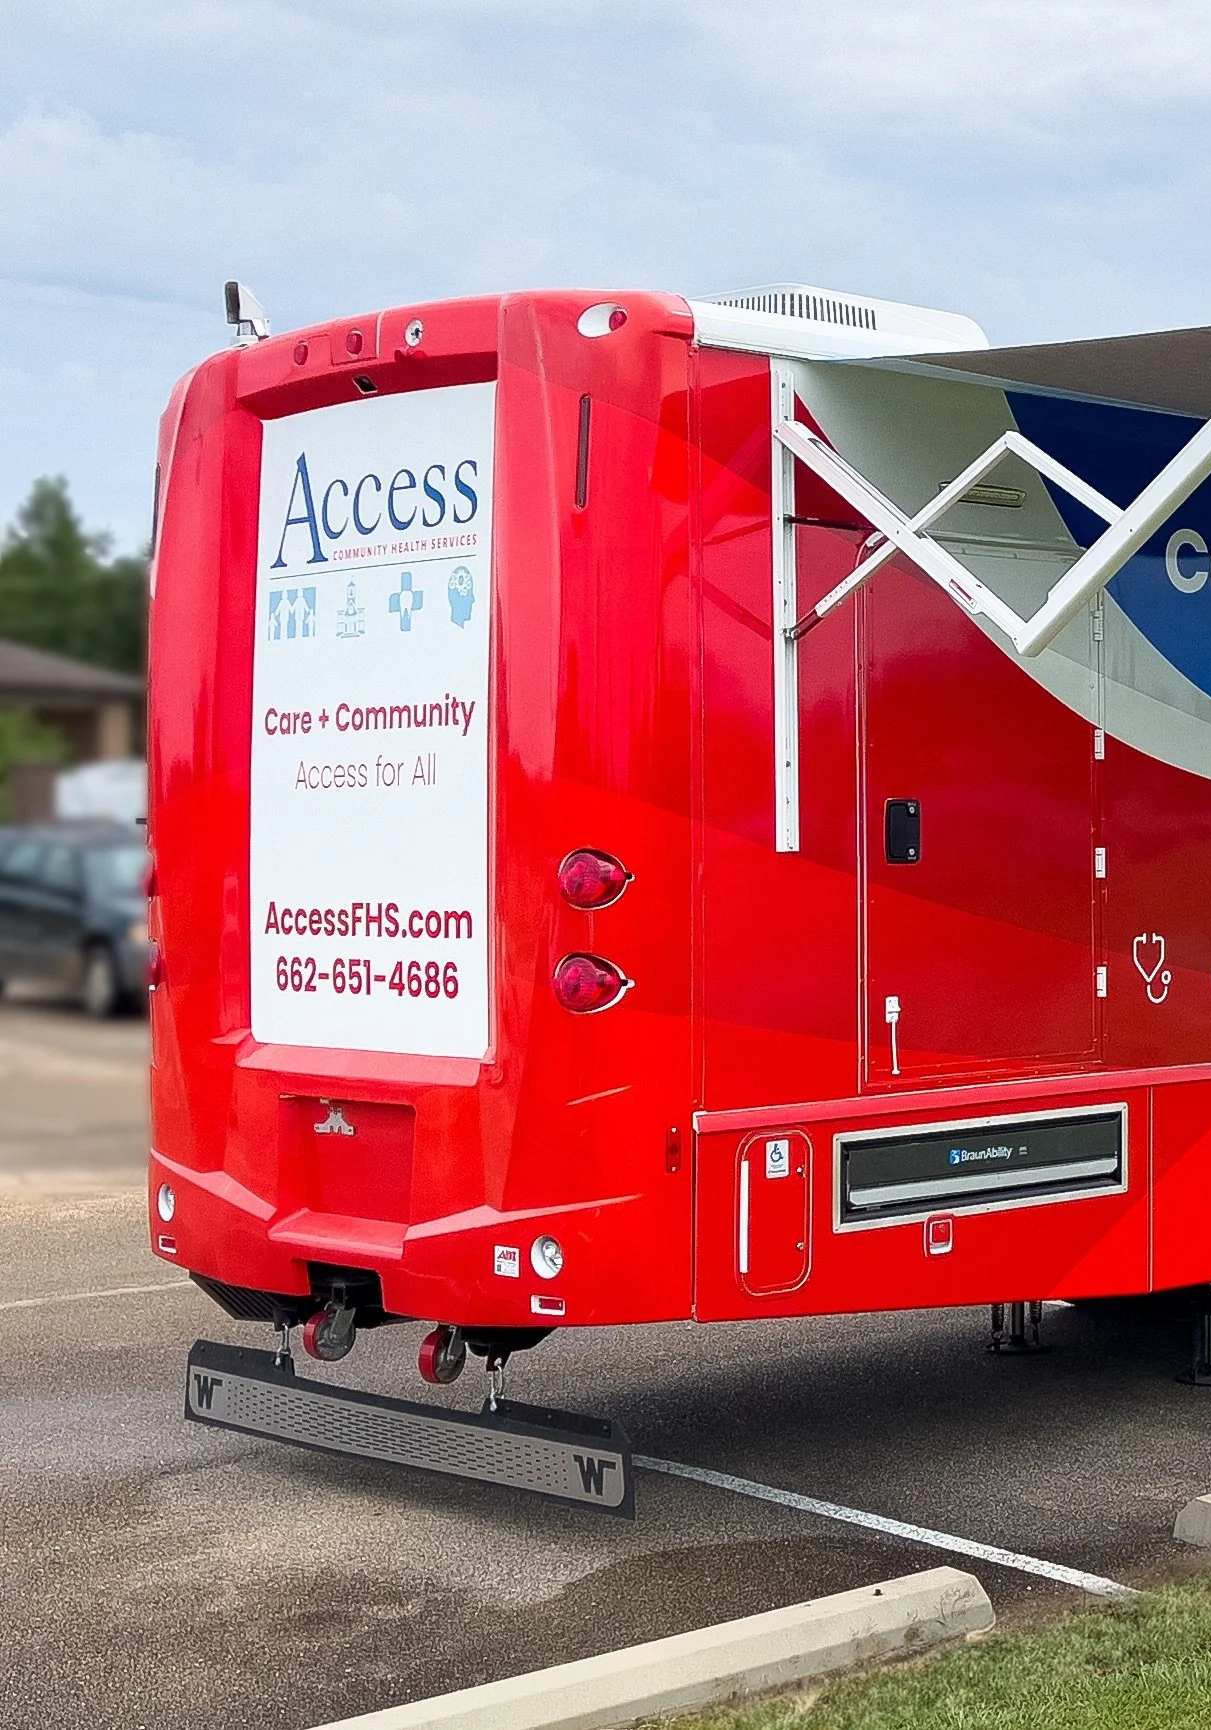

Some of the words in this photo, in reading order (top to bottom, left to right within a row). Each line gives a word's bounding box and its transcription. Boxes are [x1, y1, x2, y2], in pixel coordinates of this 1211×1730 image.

[270, 451, 478, 569] Access
[333, 544, 388, 561] COMMUNITY
[391, 539, 427, 555] HEALTH
[431, 534, 478, 551] SERVICES
[264, 708, 312, 736] Care
[318, 708, 329, 729] +
[335, 693, 475, 736] Community
[295, 760, 368, 790] Access
[376, 754, 404, 787] for
[412, 752, 436, 786] All
[264, 901, 473, 939] AccessFHS.com
[276, 956, 459, 999] 662-651-4686
